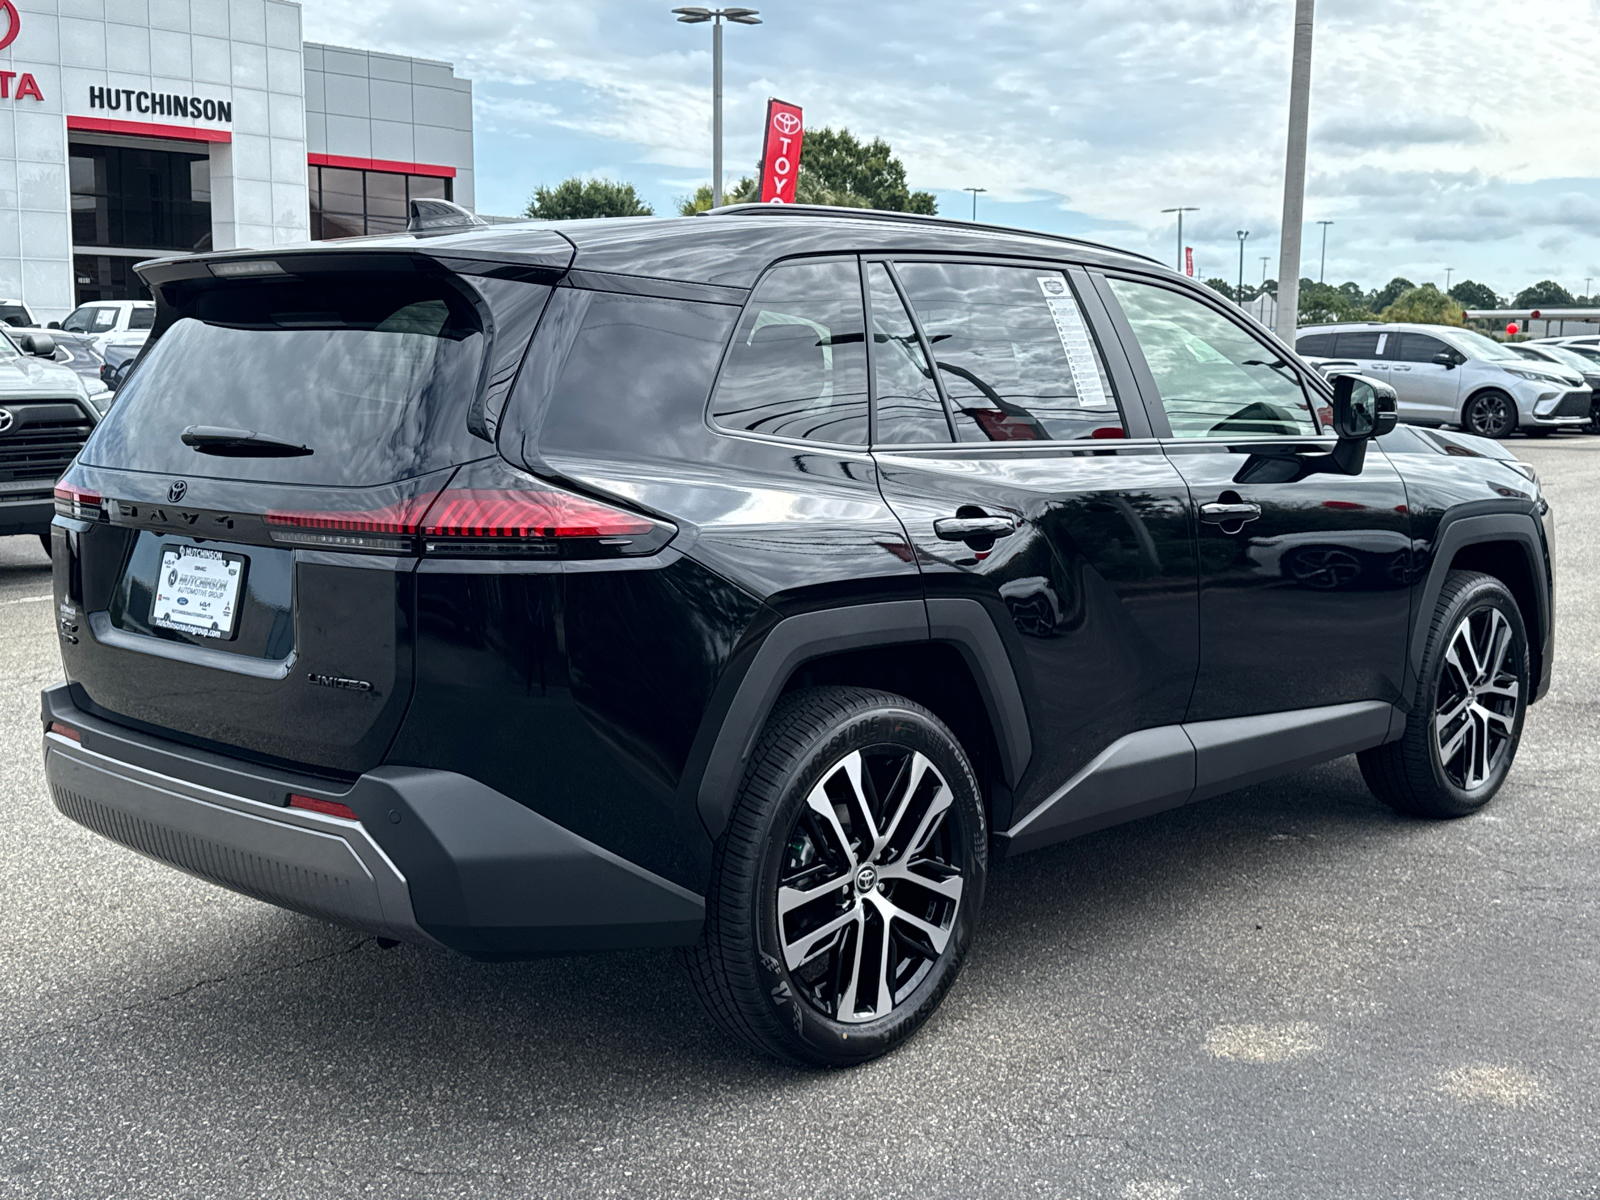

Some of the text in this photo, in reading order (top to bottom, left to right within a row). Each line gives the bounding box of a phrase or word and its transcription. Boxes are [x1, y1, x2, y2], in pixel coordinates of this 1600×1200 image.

[89, 86, 232, 122] HUTCHINSON
[120, 505, 234, 529] RAV4
[186, 547, 222, 560] HUTCHINSON
[179, 574, 228, 591] HUTCHINSON
[177, 586, 224, 599] AUTOMOTIVE GROUP
[307, 673, 375, 692] LIMITED
[948, 740, 985, 831] TURANZA
